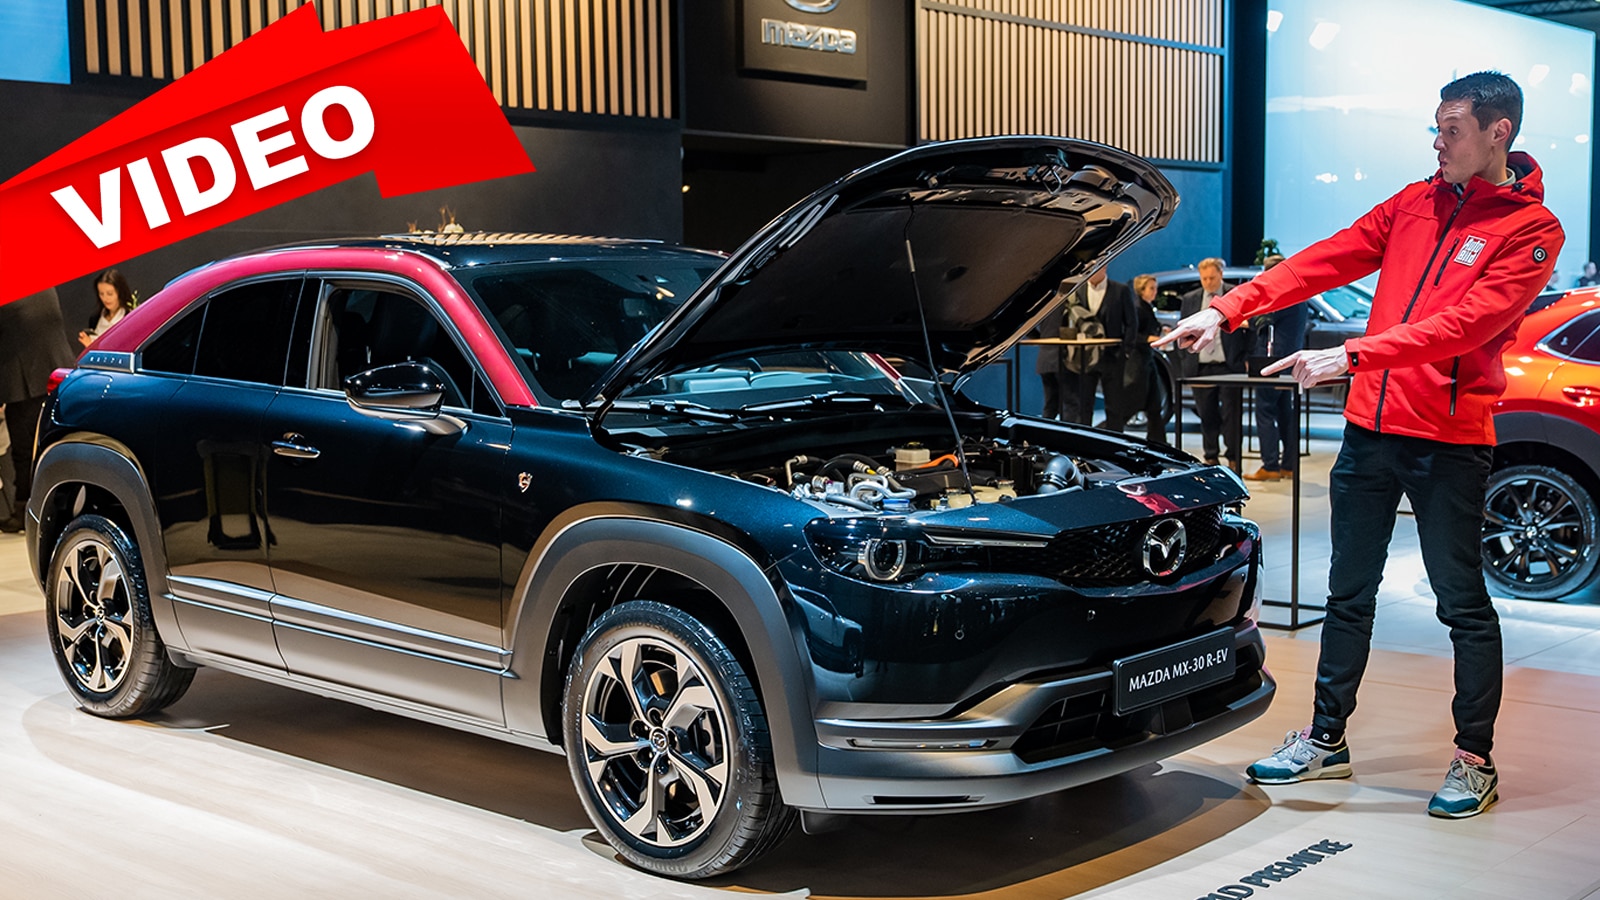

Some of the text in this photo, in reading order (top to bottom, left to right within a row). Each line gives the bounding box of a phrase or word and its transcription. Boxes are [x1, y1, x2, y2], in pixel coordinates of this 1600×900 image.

[1129, 648, 1228, 692] MAZDA MX-30 R-EV
